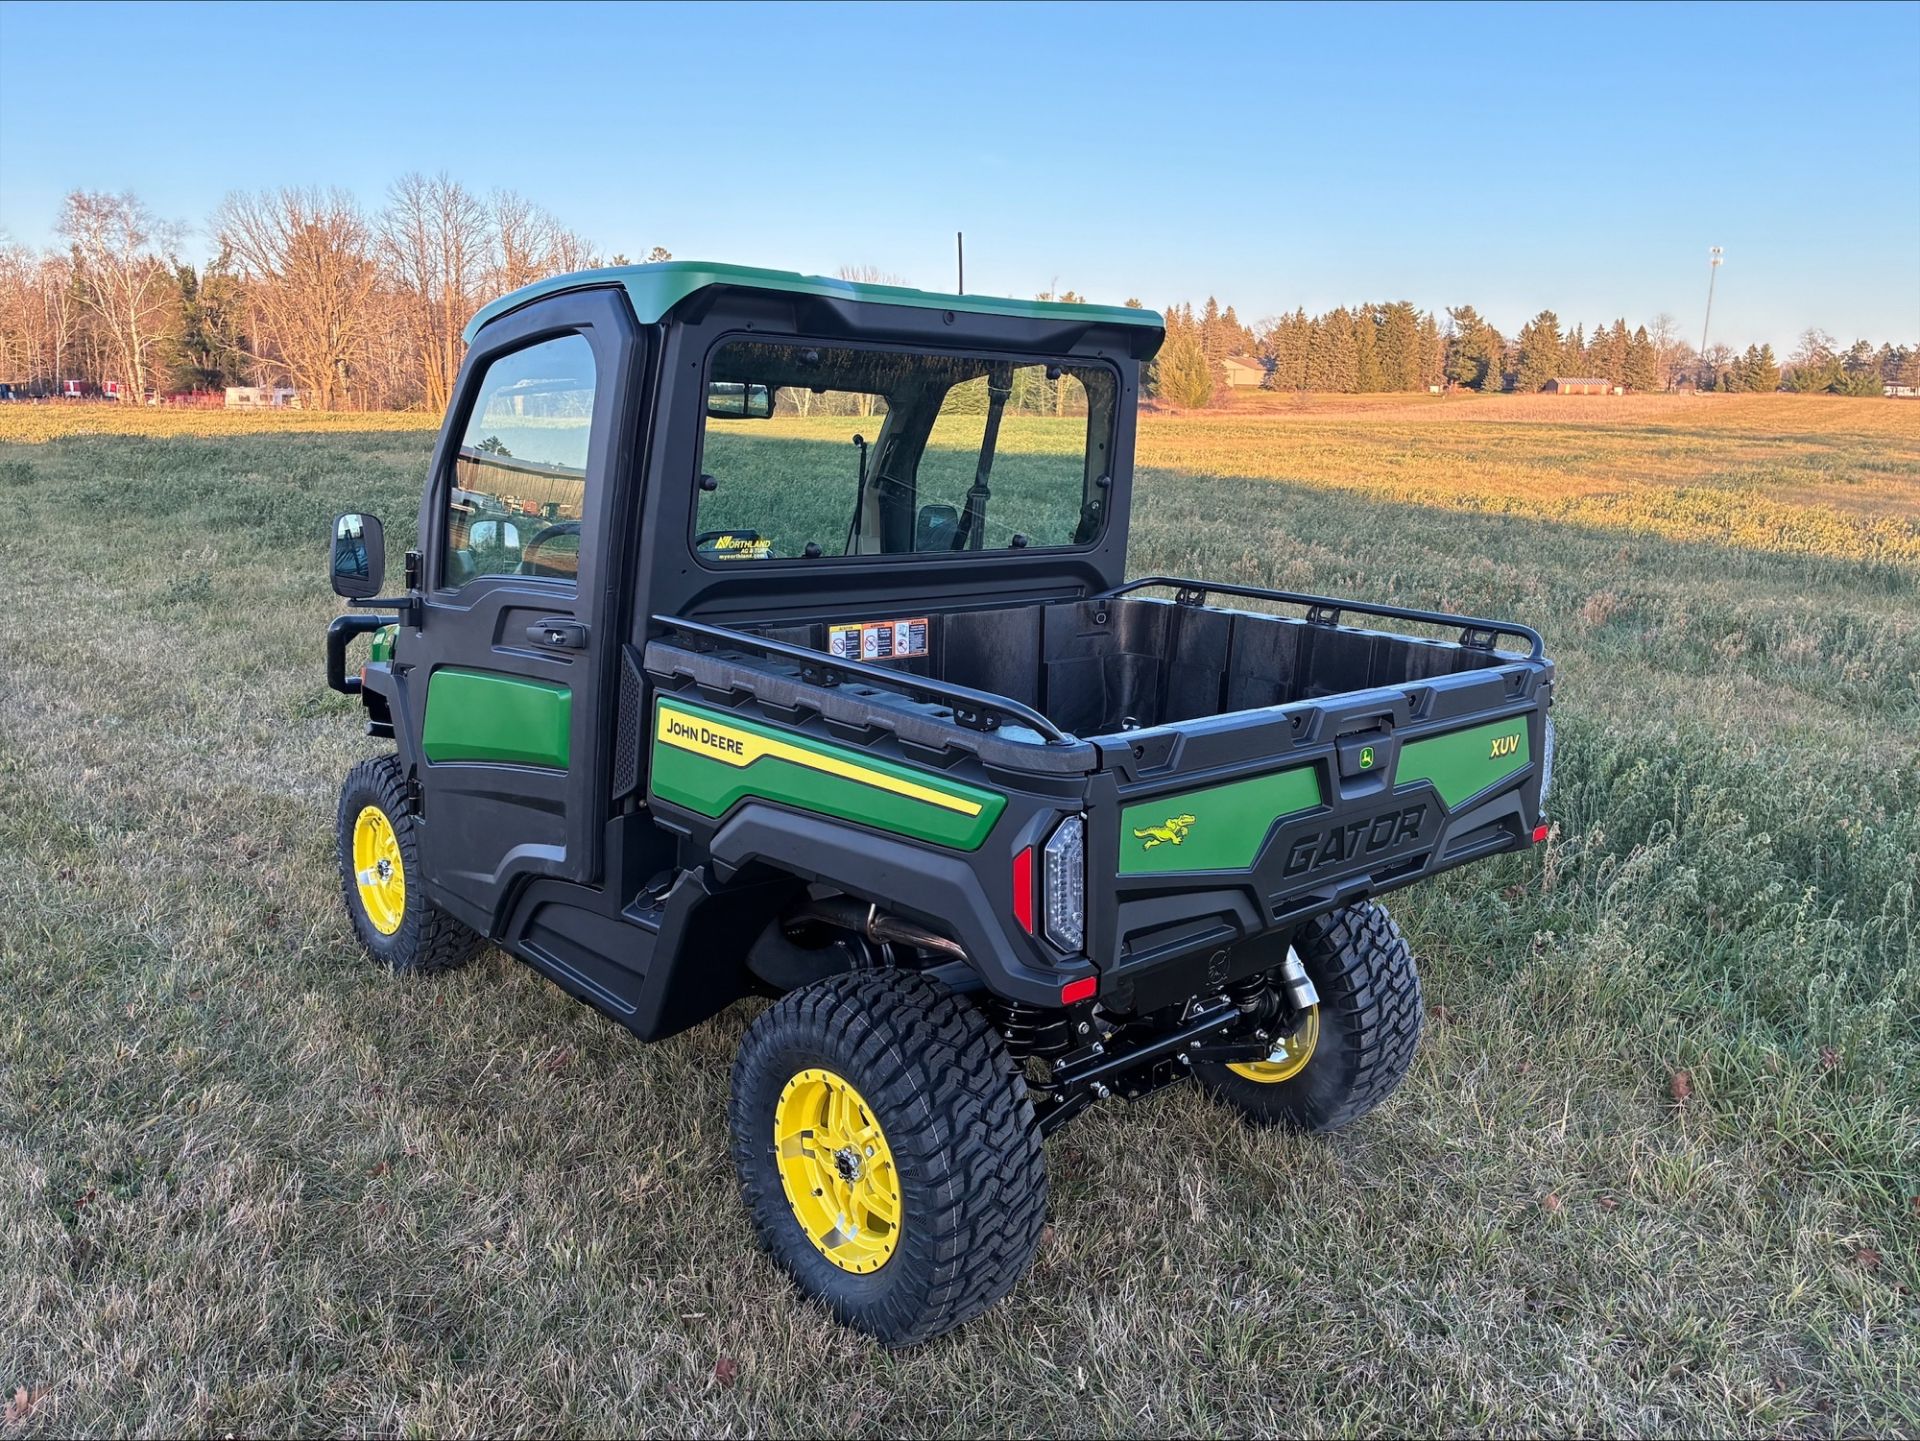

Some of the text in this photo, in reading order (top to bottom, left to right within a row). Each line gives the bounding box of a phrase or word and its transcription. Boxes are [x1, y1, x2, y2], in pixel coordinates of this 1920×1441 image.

[714, 535, 771, 549] NORTHLAND
[666, 717, 744, 756] JOHN DEERE
[1489, 733, 1520, 760] XUV
[1283, 803, 1427, 878] GATOR
